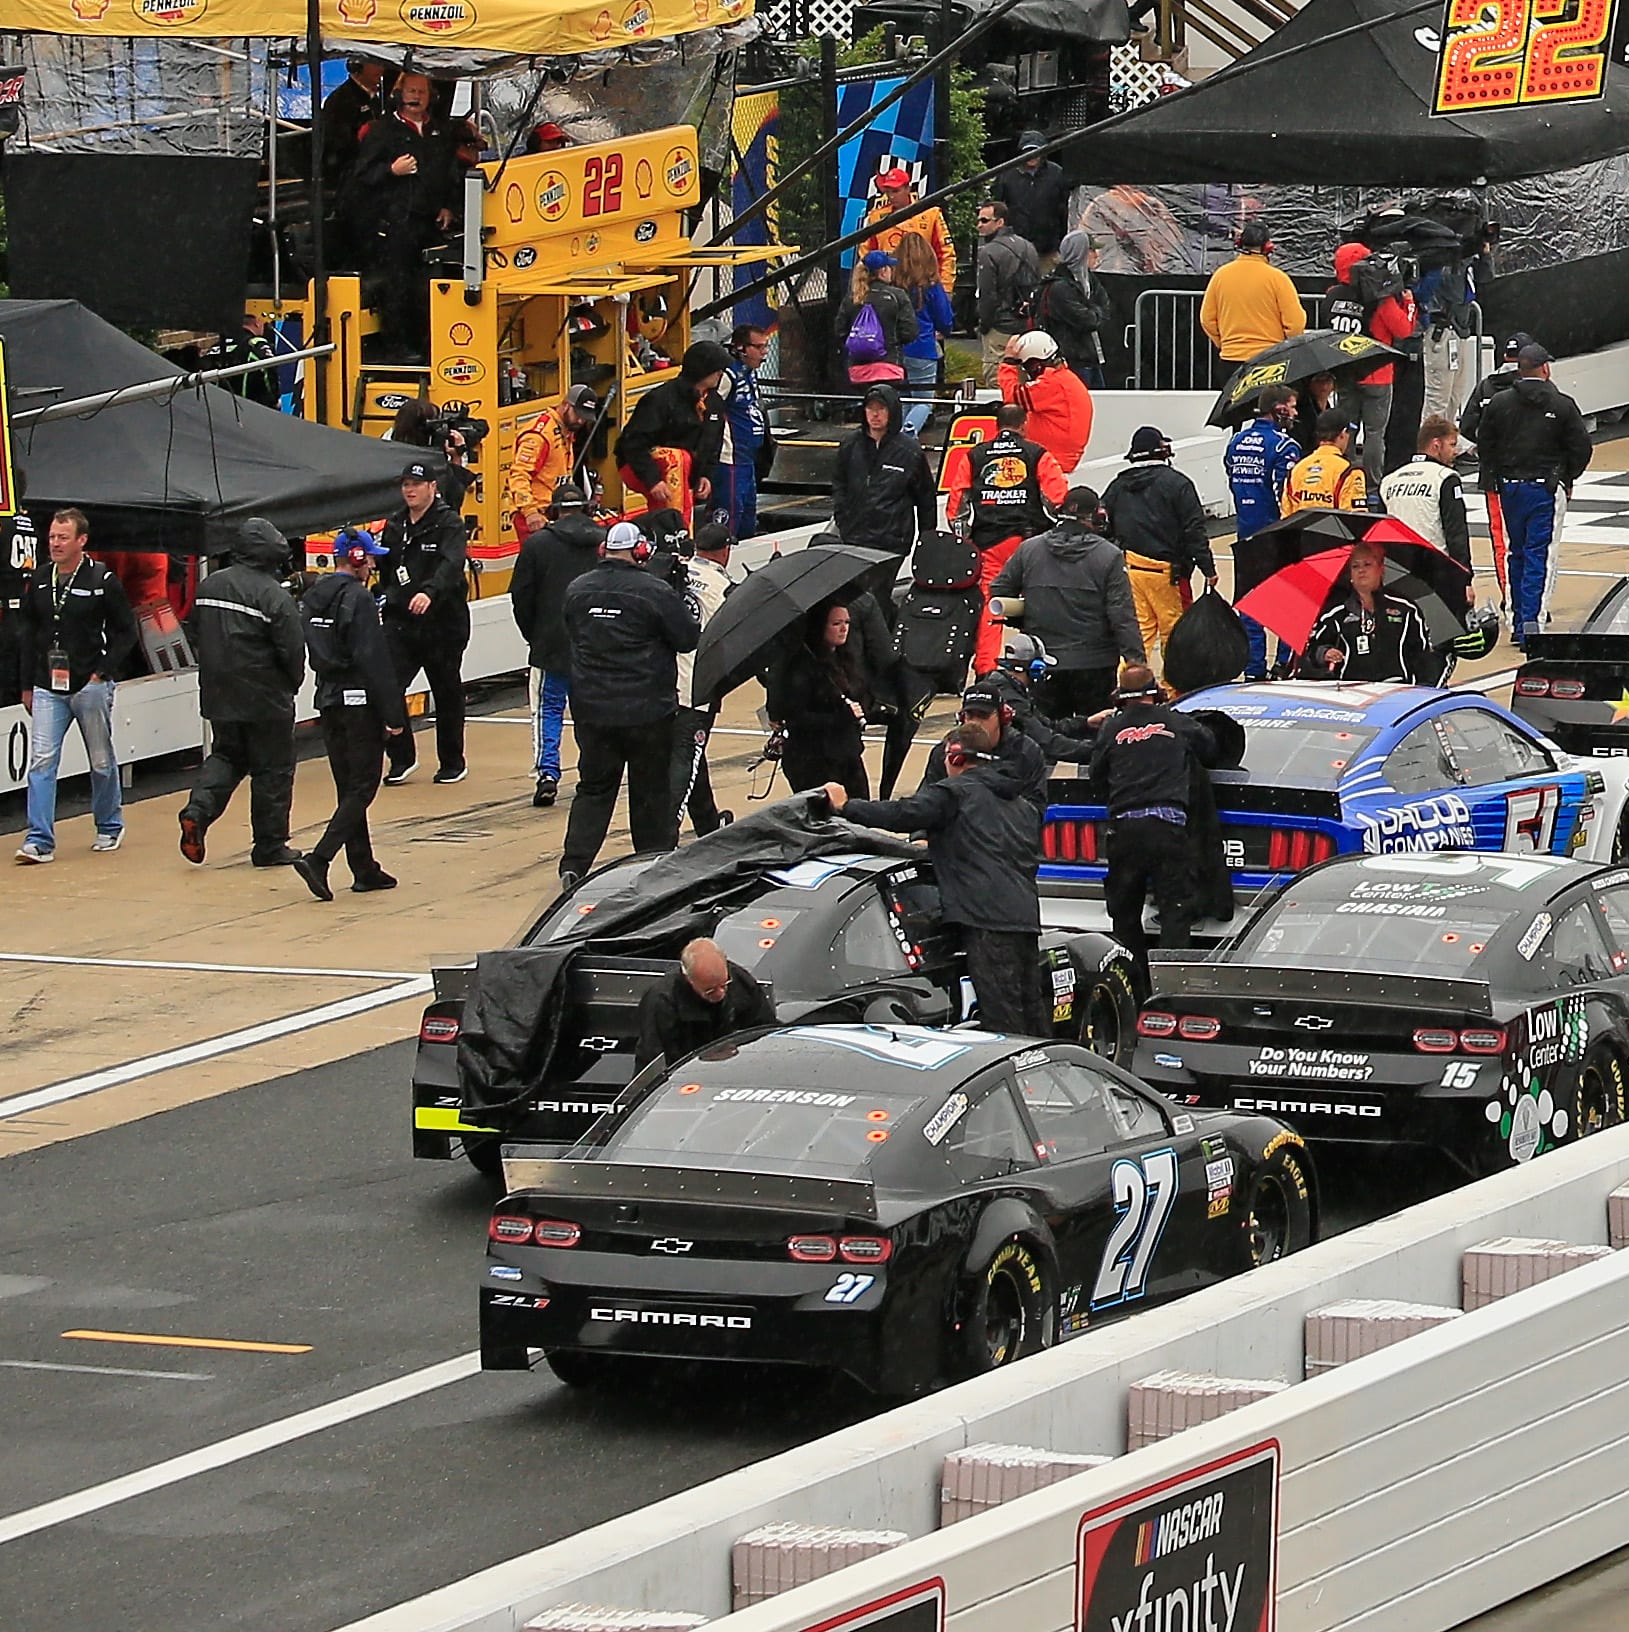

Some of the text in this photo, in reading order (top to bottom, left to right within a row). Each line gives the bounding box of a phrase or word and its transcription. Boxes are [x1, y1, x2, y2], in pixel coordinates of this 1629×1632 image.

[409, 5, 468, 24] PENNZOIL
[583, 153, 624, 218] 22
[981, 490, 1027, 500] TRACKER
[1387, 483, 1432, 500] OFFICIAL
[10, 534, 38, 569] CAT
[1377, 794, 1471, 835] JACOB
[1504, 785, 1561, 854] 51
[1382, 826, 1475, 856] COMPANIES
[1350, 889, 1412, 900] Center
[1259, 1047, 1369, 1065] Do You Know
[1529, 1044, 1561, 1070] Center
[1249, 1061, 1373, 1081] Your Numbers?
[1439, 1062, 1482, 1089] 15
[713, 1087, 857, 1109] SORENSON
[1234, 1098, 1382, 1117] CAMARO
[1092, 1147, 1179, 1312] 27
[823, 1272, 876, 1305] 27
[590, 1306, 752, 1329] CAMARO
[1155, 1490, 1225, 1558] NASCAR
